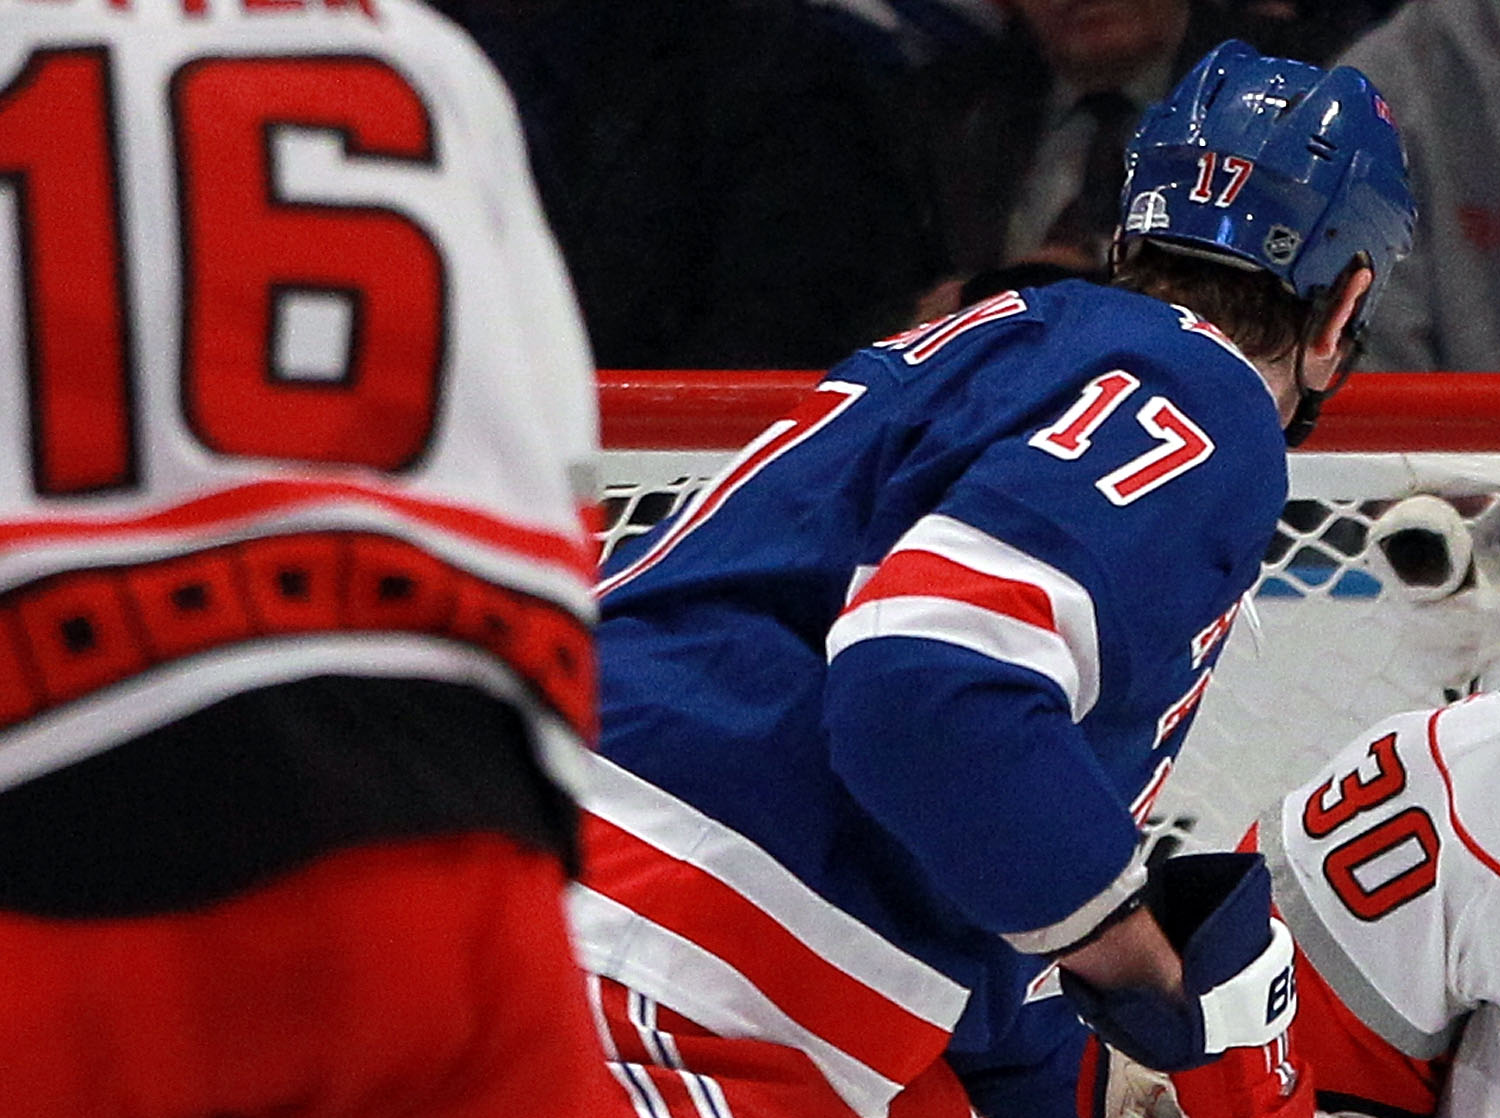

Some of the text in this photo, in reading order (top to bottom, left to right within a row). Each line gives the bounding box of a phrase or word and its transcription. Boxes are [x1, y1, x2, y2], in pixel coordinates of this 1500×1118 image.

[1189, 152, 1254, 208] 17
[0, 44, 450, 498] 16
[1029, 370, 1215, 506] 17
[1302, 731, 1442, 922] 30
